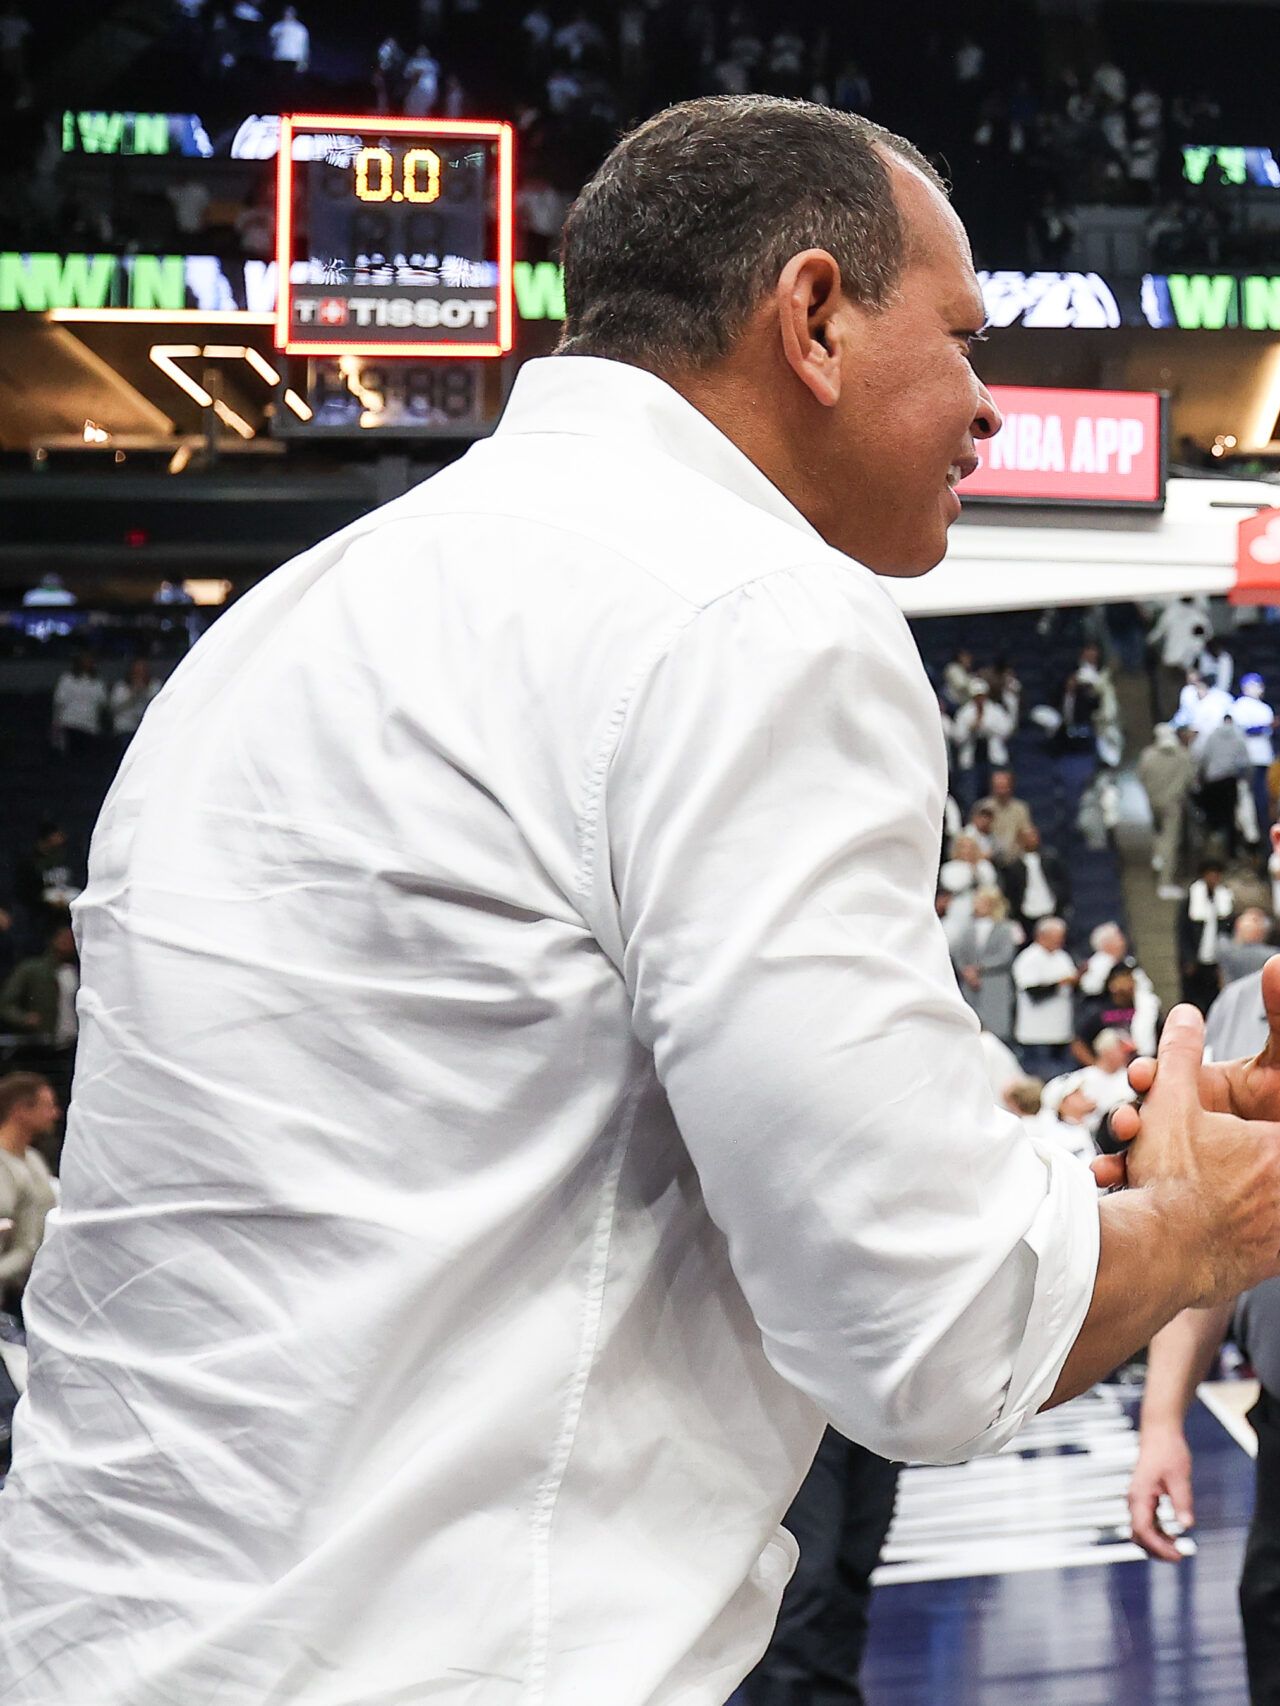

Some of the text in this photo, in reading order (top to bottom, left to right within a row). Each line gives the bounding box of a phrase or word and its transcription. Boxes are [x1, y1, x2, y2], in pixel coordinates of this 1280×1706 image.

[355, 147, 441, 203] 0.0
[348, 298, 497, 328] TISSOT
[989, 413, 1144, 475] NBA APP
